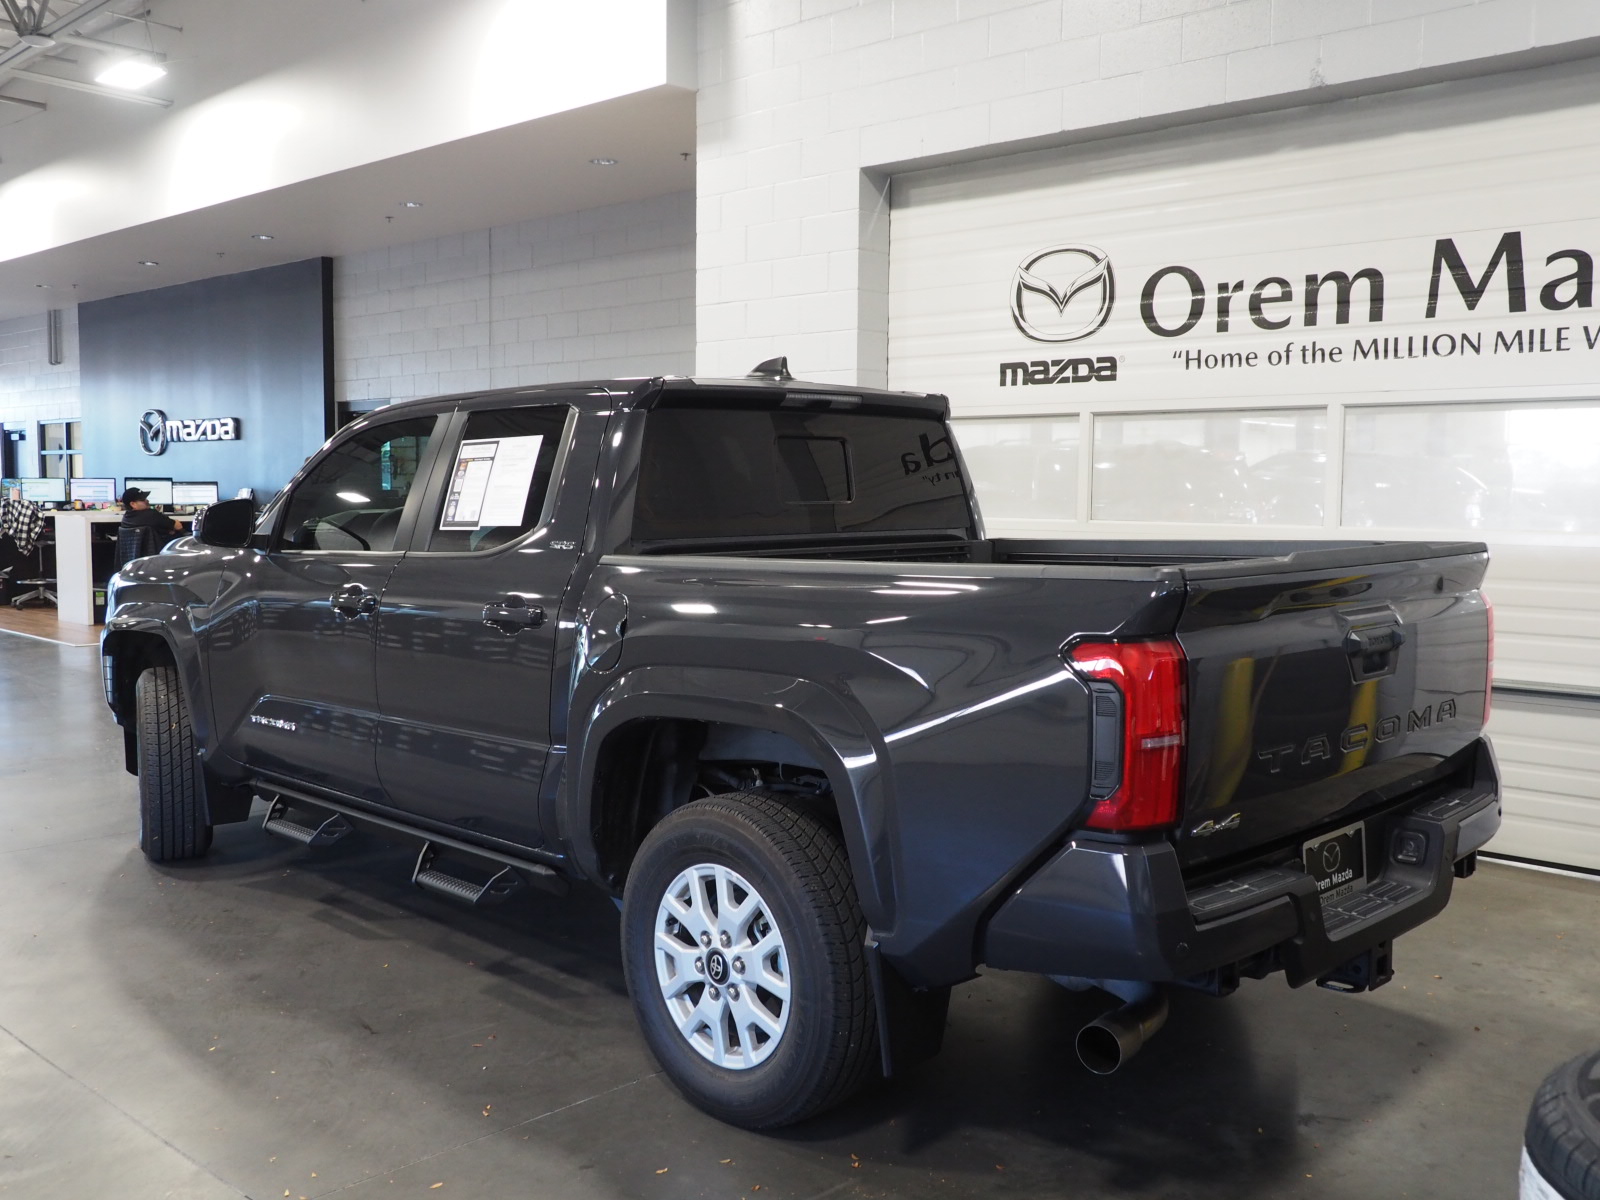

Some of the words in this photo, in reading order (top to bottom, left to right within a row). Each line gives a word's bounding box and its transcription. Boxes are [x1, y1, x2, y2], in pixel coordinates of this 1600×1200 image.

[1140, 265, 1385, 338] Orem
[1425, 231, 1594, 319] Ma
[1172, 348, 1258, 371] “Home
[1267, 342, 1295, 367] of
[1300, 341, 1343, 365] the
[1353, 332, 1482, 362] MILLION
[1493, 326, 1571, 355] MILE
[1258, 698, 1456, 773] TACOMA
[1315, 878, 1331, 891] rem
[1332, 868, 1353, 885] Mazda
[1335, 885, 1353, 898] Mazda
